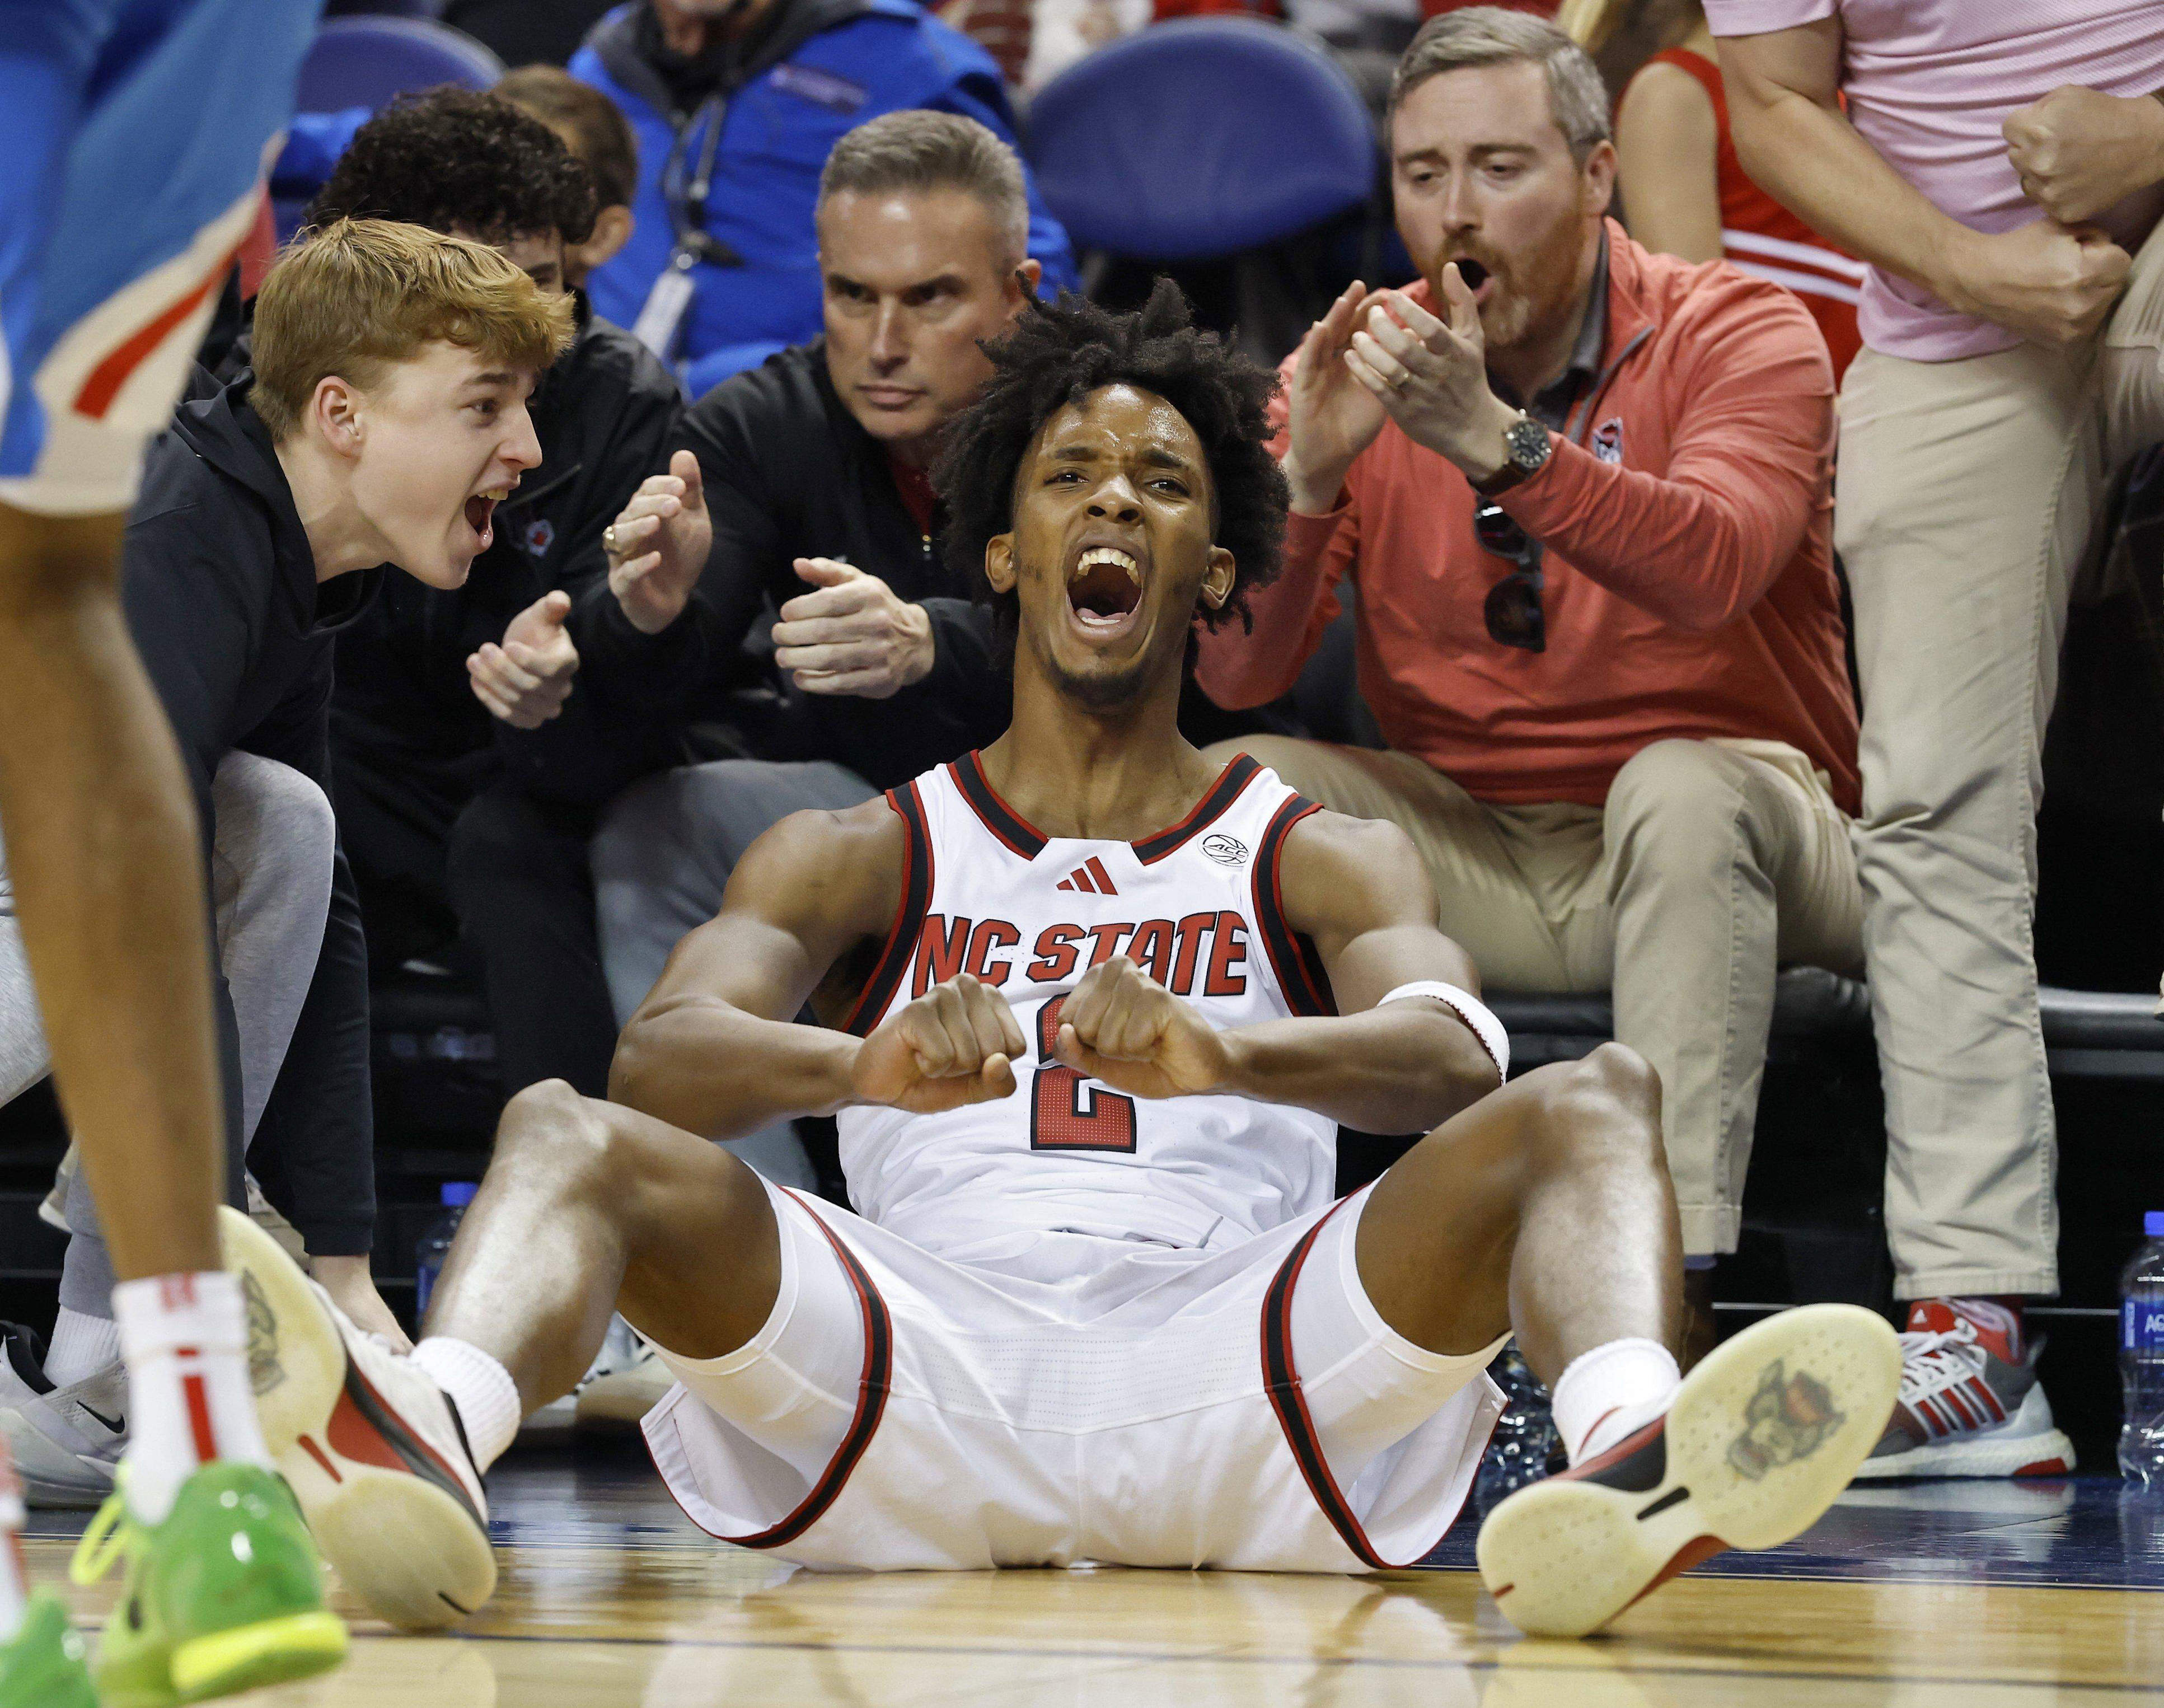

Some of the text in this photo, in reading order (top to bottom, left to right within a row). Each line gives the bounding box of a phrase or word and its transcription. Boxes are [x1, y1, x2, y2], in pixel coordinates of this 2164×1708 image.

[1208, 844, 1248, 858] ACC
[911, 910, 1249, 1000] NC STATE
[1031, 991, 1137, 1154] 2
